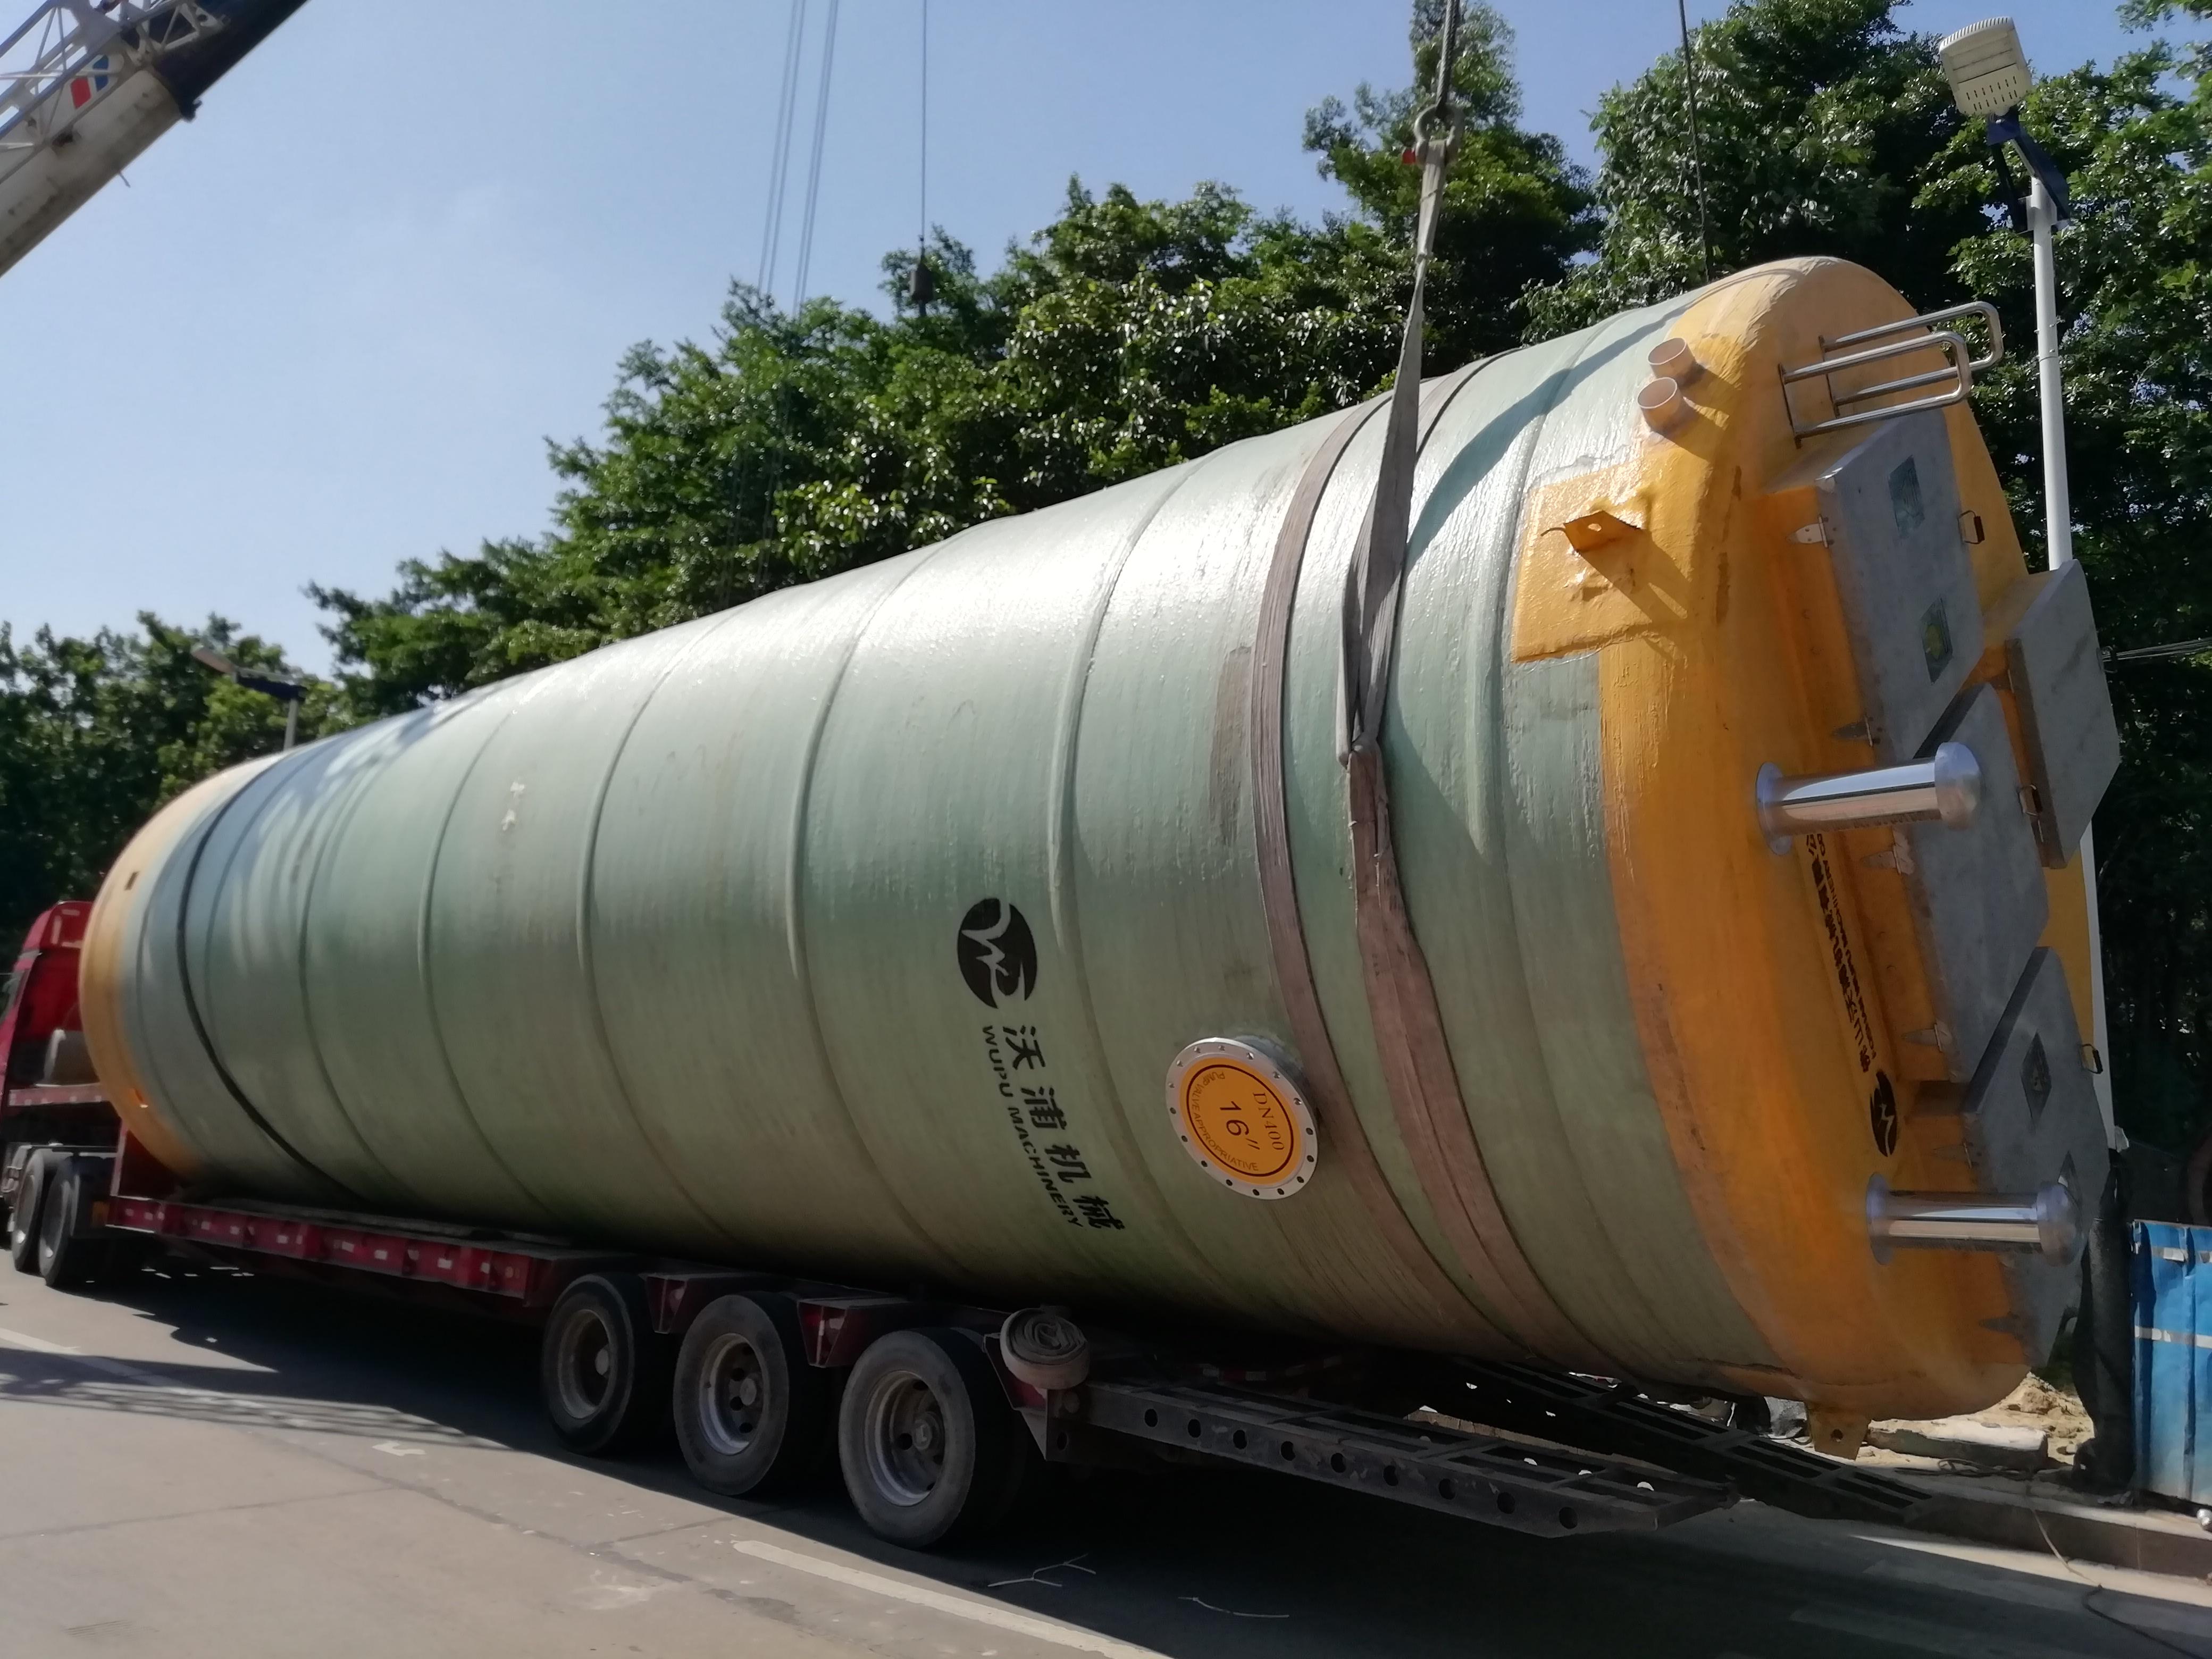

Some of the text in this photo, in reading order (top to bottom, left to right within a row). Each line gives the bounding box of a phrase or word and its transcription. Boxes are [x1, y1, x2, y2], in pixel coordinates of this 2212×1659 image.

[982, 1025, 1084, 1228] WUPU MACHINERY
[1002, 1025, 1126, 1230] 沃浦机械
[1192, 1071, 1259, 1171] PUMP VALVE APPROPRIATIVE
[1253, 1092, 1285, 1151] DN400
